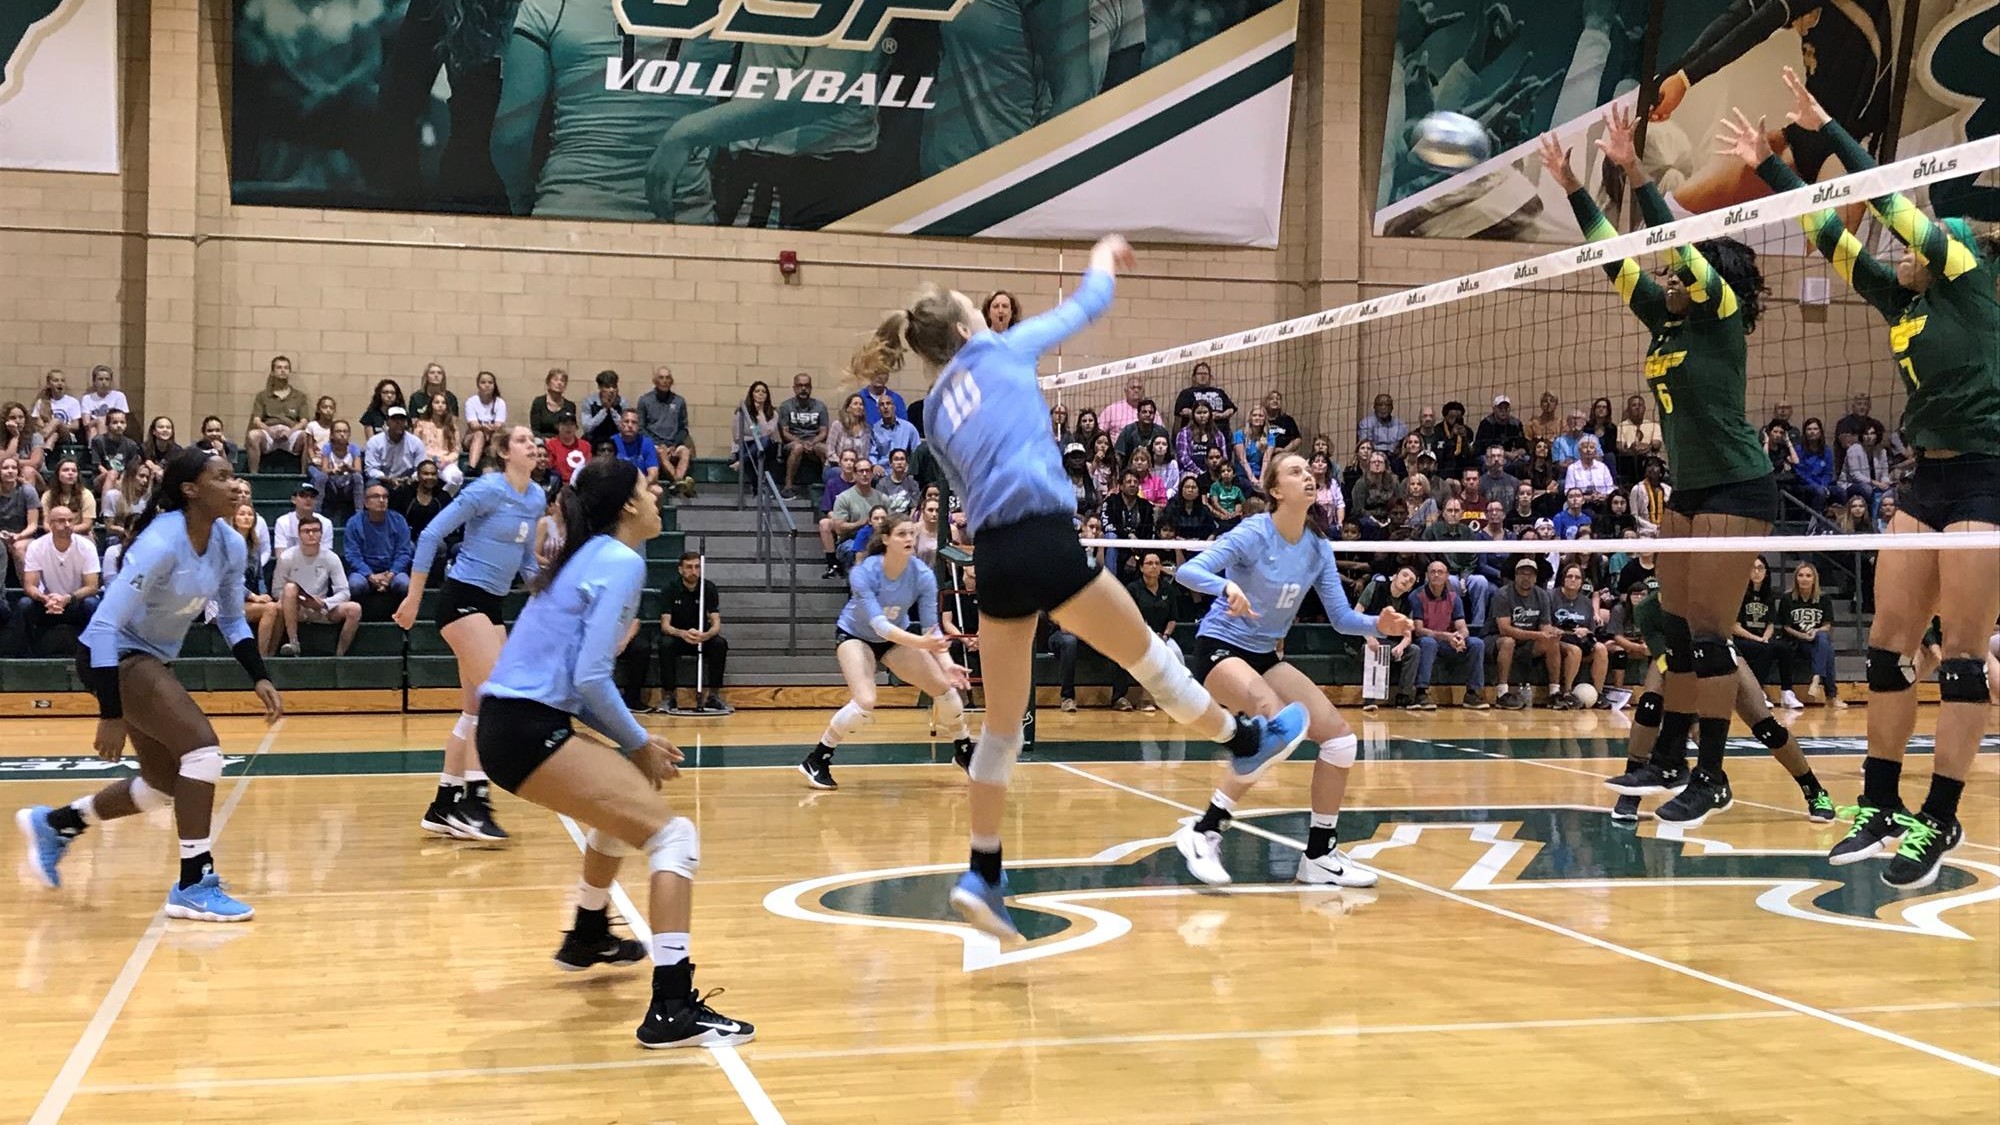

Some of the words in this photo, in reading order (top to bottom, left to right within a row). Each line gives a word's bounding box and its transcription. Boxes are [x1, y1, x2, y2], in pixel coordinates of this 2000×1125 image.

[605, 57, 936, 109] VOLLEYBALL
[1576, 248, 1603, 264] BULLS
[1646, 228, 1676, 246] BULLS
[1724, 207, 1759, 226] BULLS
[1812, 183, 1850, 204] BULLS
[1913, 156, 1958, 179] BULLS
[1899, 356, 1920, 390] 7
[942, 368, 982, 434] 10
[1656, 382, 1674, 414] 6
[790, 411, 819, 424] USF
[1276, 583, 1300, 608] 12
[1790, 608, 1824, 624] USF
